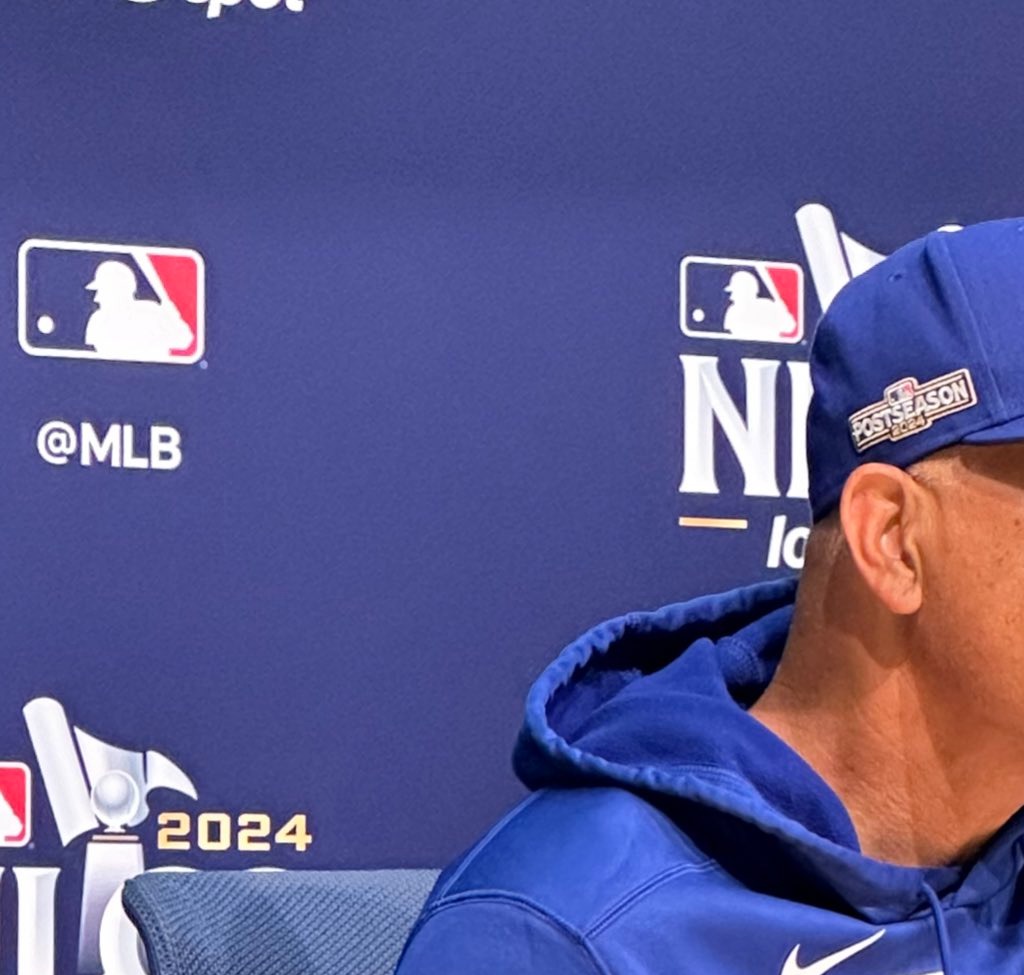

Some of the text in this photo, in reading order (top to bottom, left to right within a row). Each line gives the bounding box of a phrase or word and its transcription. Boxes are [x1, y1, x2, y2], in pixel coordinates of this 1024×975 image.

[852, 379, 970, 443] POSTSEASON
[891, 414, 926, 437] 2024
[36, 419, 183, 471] @MLB
[157, 811, 313, 852] 2024
